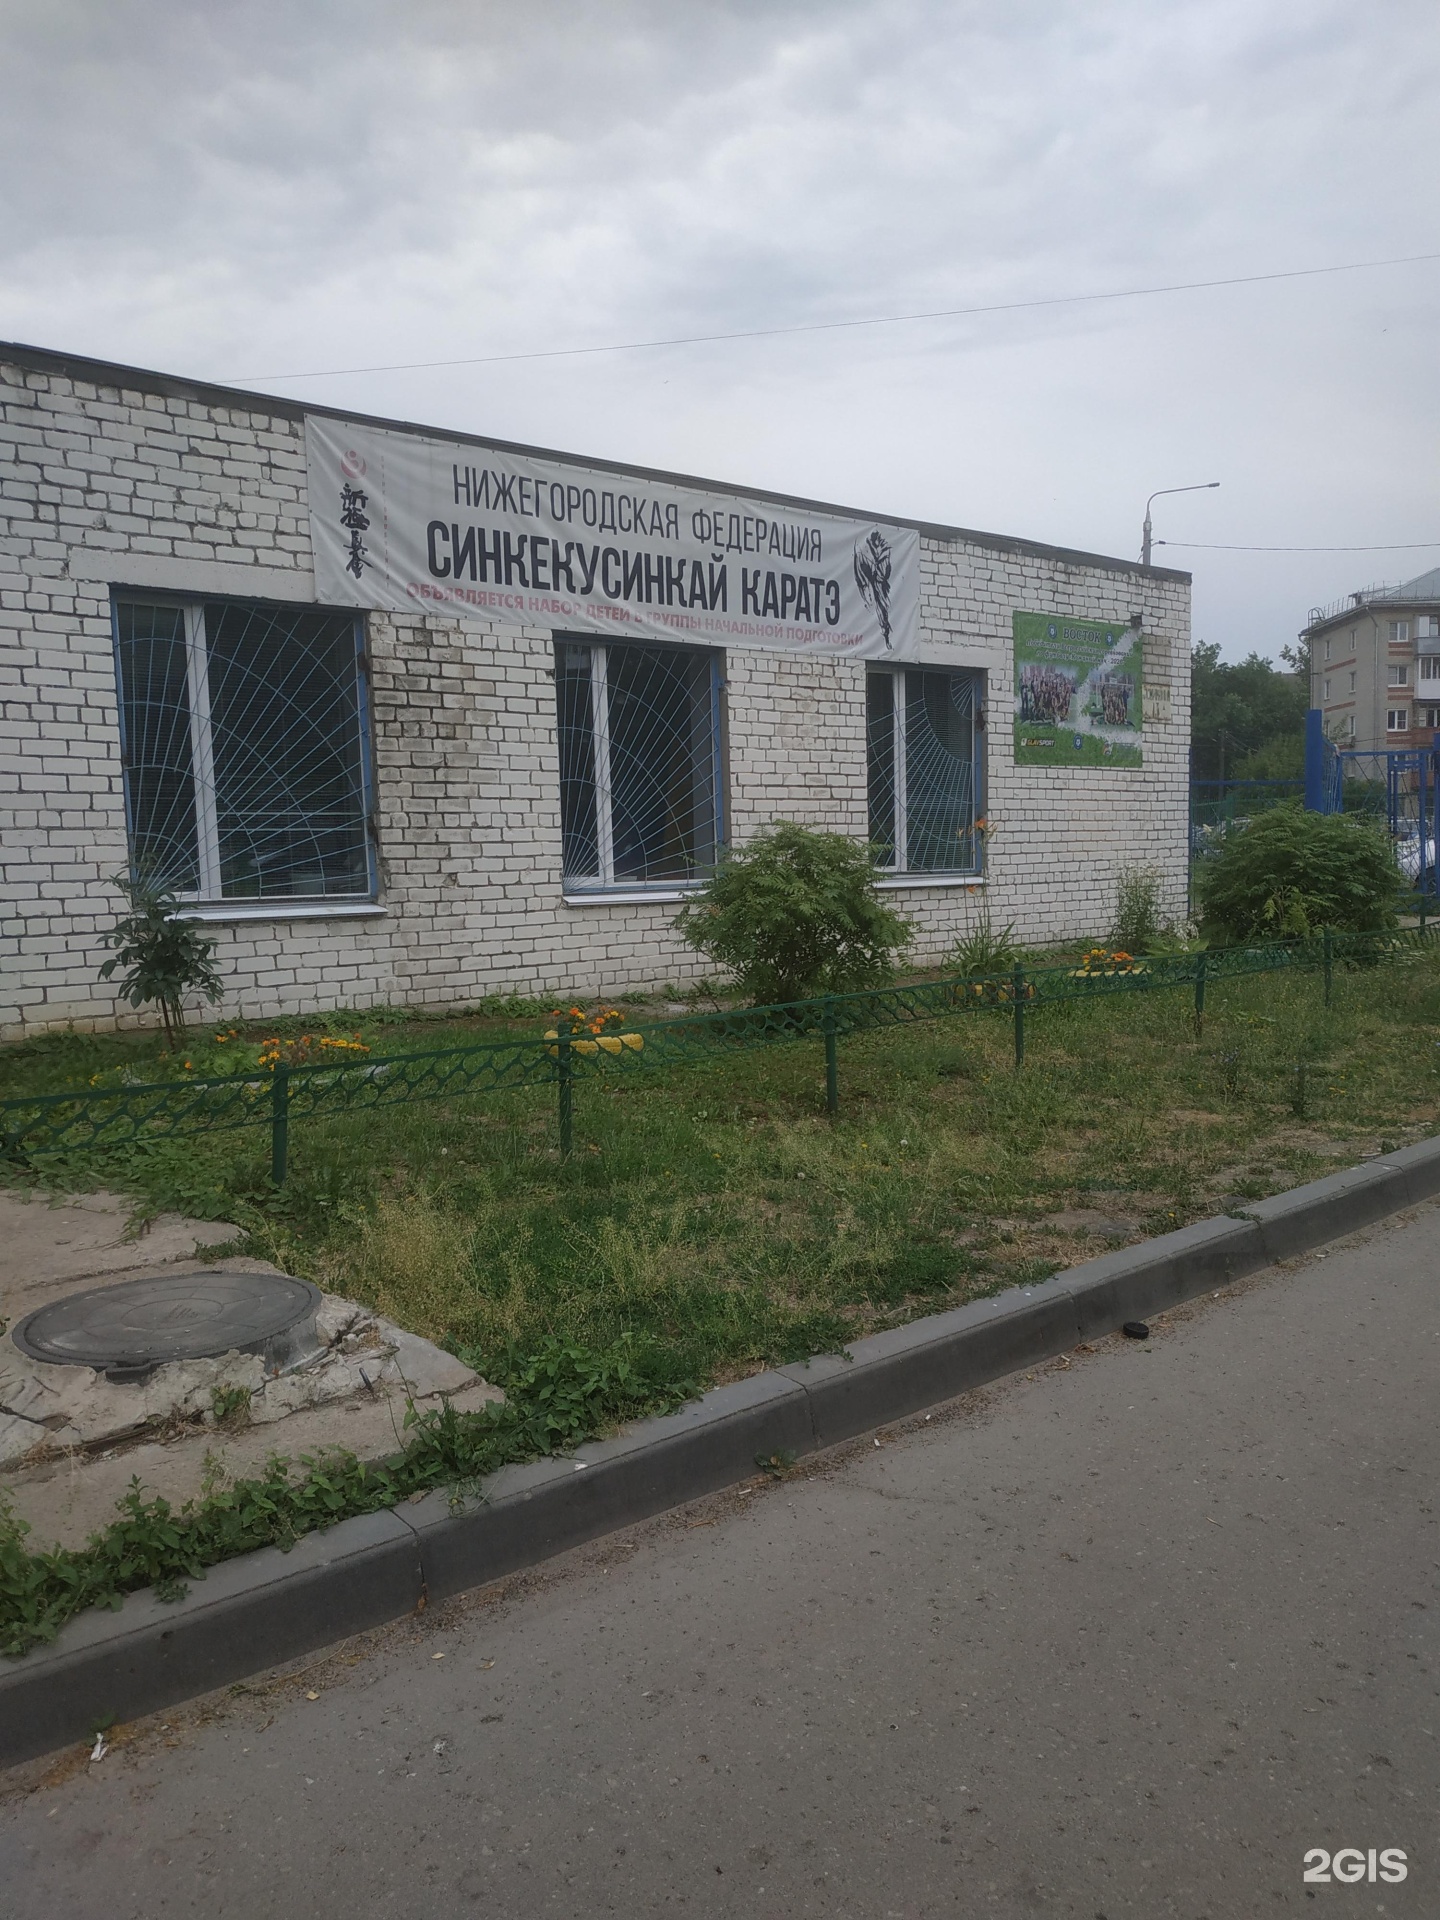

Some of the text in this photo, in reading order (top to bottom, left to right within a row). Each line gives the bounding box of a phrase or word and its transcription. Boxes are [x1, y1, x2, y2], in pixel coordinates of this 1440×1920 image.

[452, 464, 680, 541] НИЖЕГОРОДСКАЯ
[691, 508, 822, 564] ФЕДЕРАЦИЯ
[406, 582, 524, 610] ОБЪЯВЛЯЕТСЯ
[528, 597, 581, 616] НАБОР
[647, 611, 701, 629] ГРУППЫ
[704, 618, 784, 639] НАЧАЛЬНОЙ
[786, 627, 864, 646] ПОДГОТОВКИ
[426, 520, 728, 613] СИНКЕКУСИНКАЙ
[741, 567, 841, 626] КАРАТЭ
[1063, 627, 1101, 643] ВОСТОК
